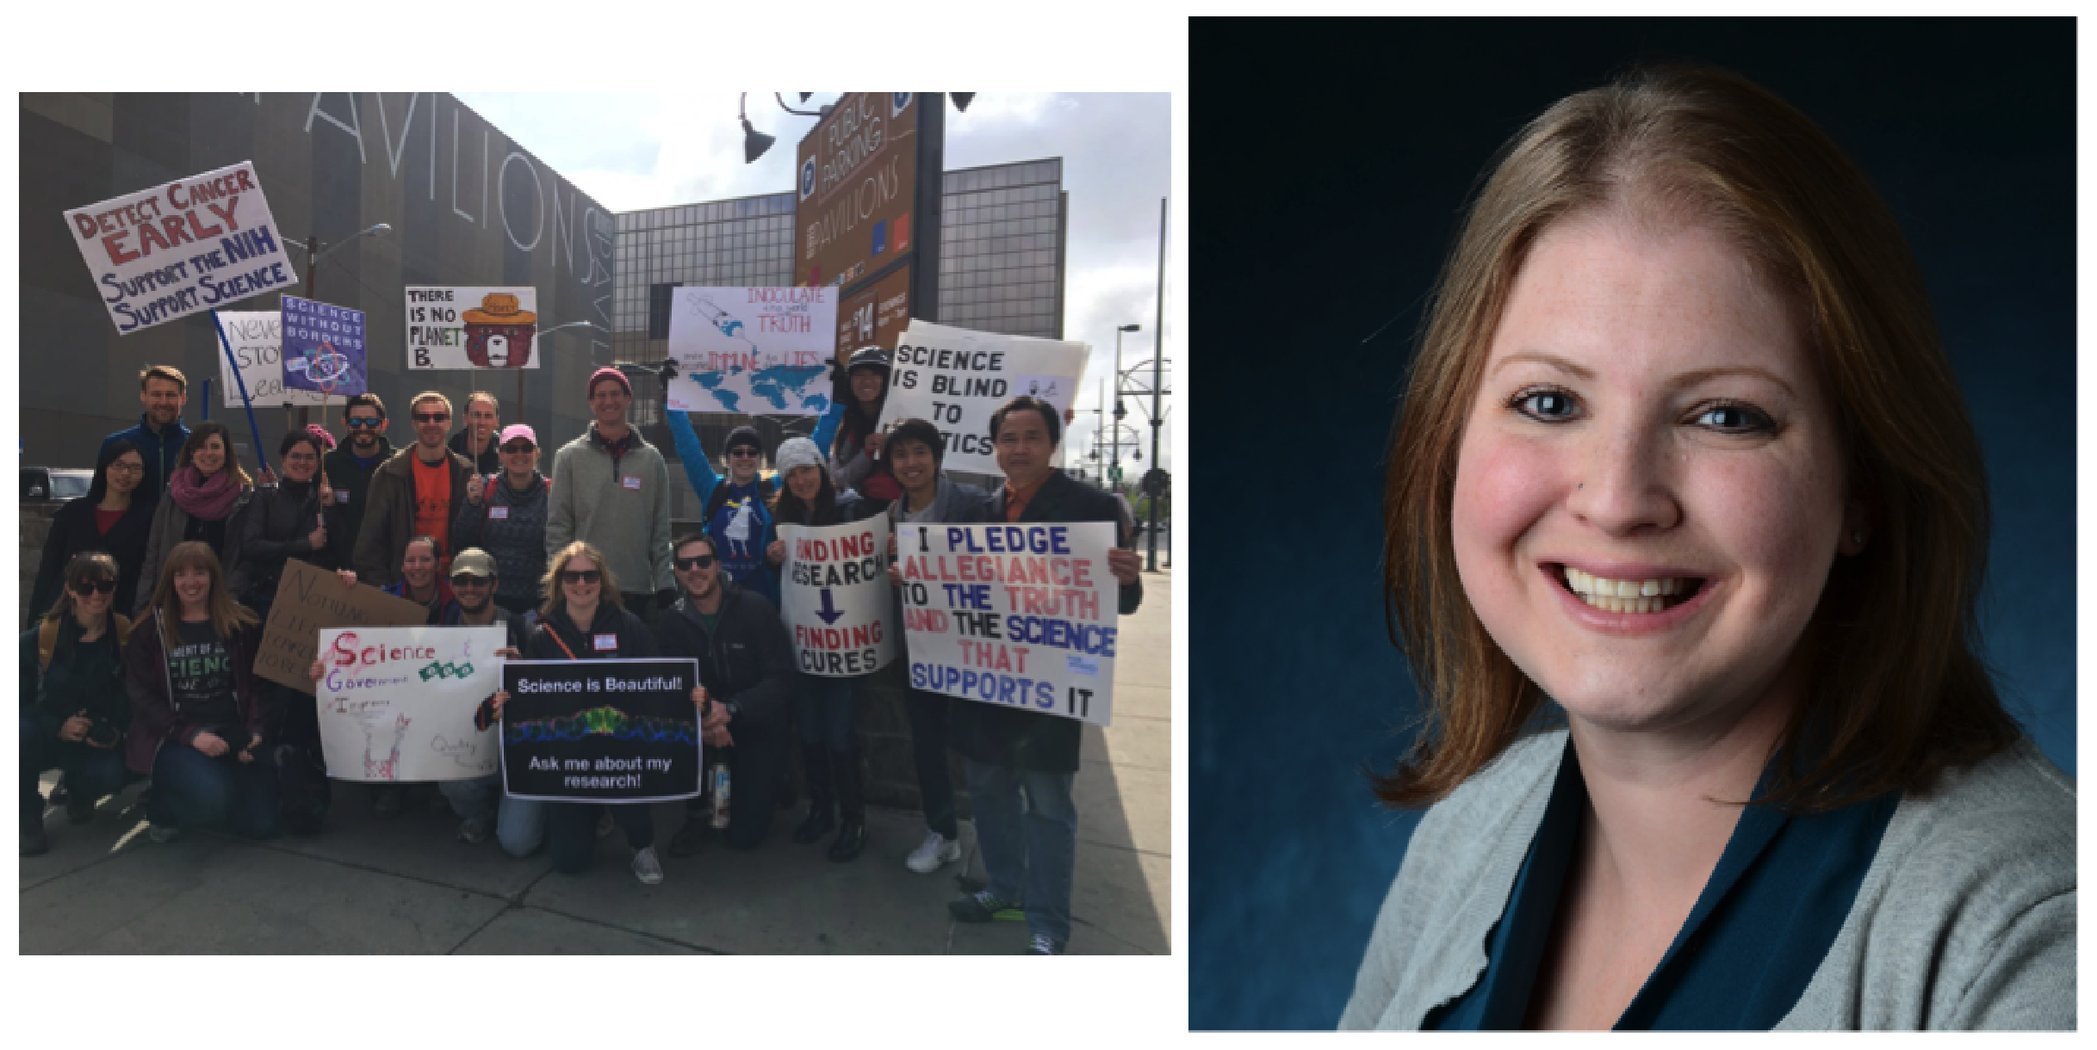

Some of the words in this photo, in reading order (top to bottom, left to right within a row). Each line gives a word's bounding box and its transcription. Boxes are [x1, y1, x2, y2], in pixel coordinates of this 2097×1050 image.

[829, 92, 875, 155] PUBLIC
[823, 117, 881, 193] PARKING
[251, 92, 599, 285] AVILIONS
[73, 196, 161, 240] DETECT
[167, 169, 255, 210] CANCER
[807, 154, 899, 259] PAVILIONS
[101, 196, 239, 266] EARLY
[101, 261, 188, 303] SUPPORT
[190, 251, 226, 274] THE
[220, 225, 277, 264] NIH
[113, 287, 200, 331] SUPPORT
[199, 262, 288, 303] SCIENCE
[408, 290, 454, 303] THERE
[747, 287, 824, 303] INOCULATE
[286, 298, 361, 323] SCIENCE
[286, 312, 362, 336] WITHOUT
[410, 307, 425, 322] IS
[430, 307, 456, 322] NO
[757, 313, 811, 333] TRUTH
[286, 326, 363, 350] BORDERS
[410, 326, 462, 347] PLANET
[237, 346, 282, 369] STO
[897, 345, 1005, 371] SCIENCE
[893, 369, 918, 389] IS
[931, 374, 1007, 398] BLIND
[931, 401, 962, 424] TO
[938, 432, 993, 456] TICS
[918, 526, 929, 552] I
[947, 526, 1071, 555] PLEDGE
[904, 555, 1094, 587] ALLEGIANCE
[902, 581, 928, 605] TO
[943, 583, 993, 610] THE
[1004, 585, 1099, 620] TRUTH
[796, 620, 883, 651] FINDING
[905, 608, 948, 633] AND
[952, 611, 1002, 639] THE
[1006, 615, 1118, 657] SCIENCE
[335, 631, 436, 668] Science
[802, 648, 877, 674] CURES
[958, 639, 1030, 673] THAT
[518, 677, 582, 693] Science
[587, 677, 600, 693] is
[605, 676, 683, 693] Beautiful!
[911, 663, 1055, 709] SUPPORTS
[1068, 687, 1094, 718] IT
[528, 755, 560, 771] Ask
[564, 758, 590, 771] me
[594, 755, 643, 771] about
[646, 757, 673, 774] my
[564, 774, 641, 789] research!
